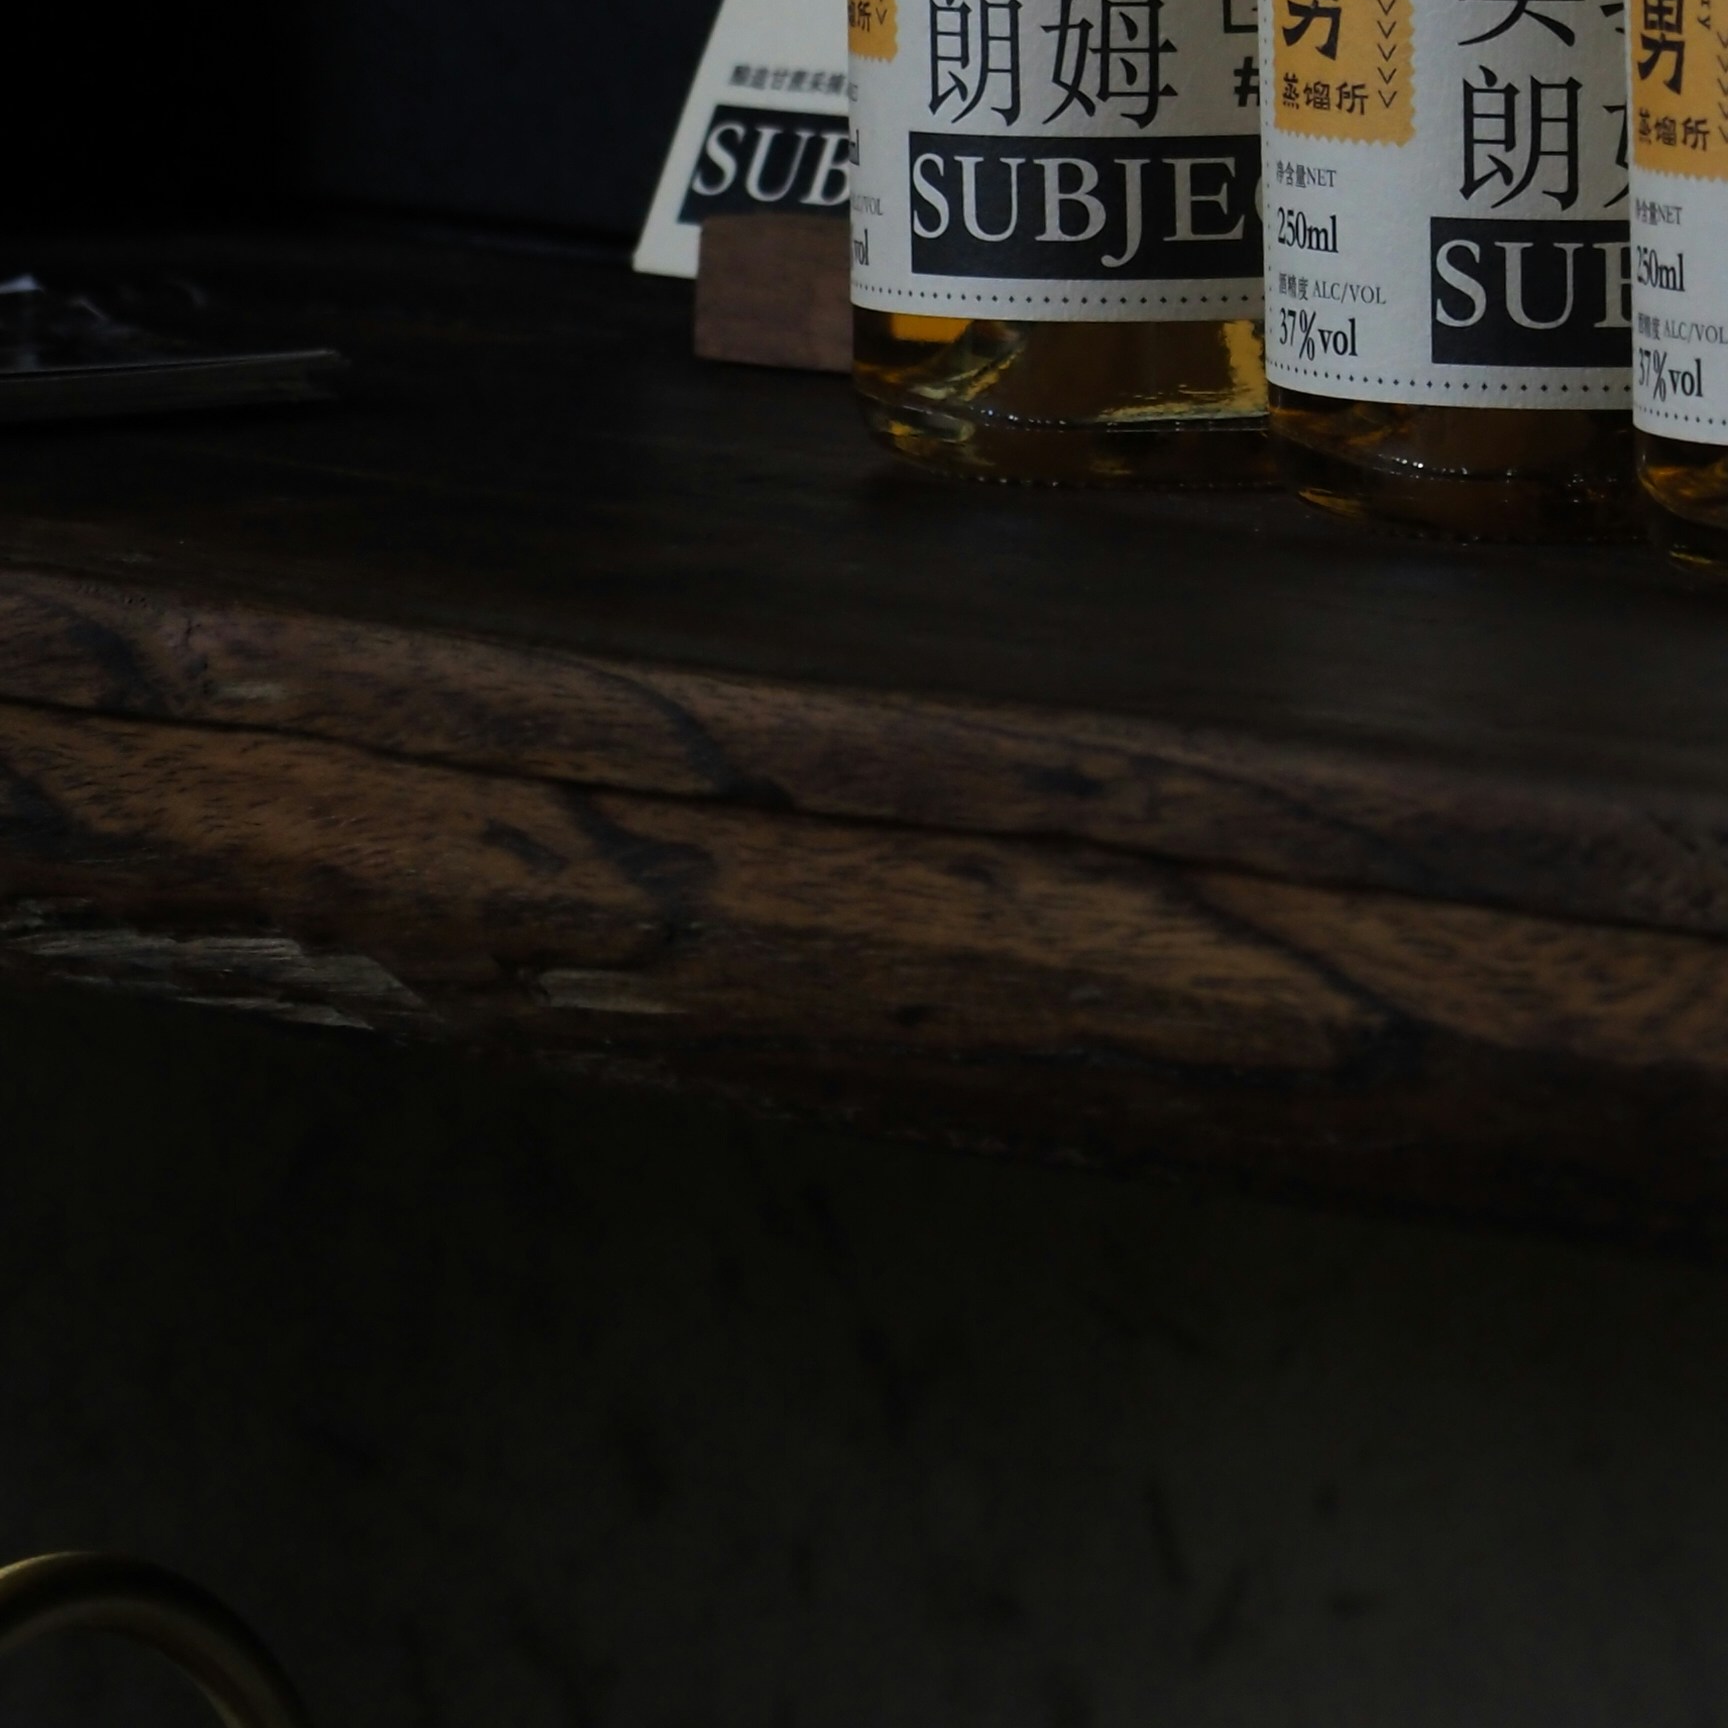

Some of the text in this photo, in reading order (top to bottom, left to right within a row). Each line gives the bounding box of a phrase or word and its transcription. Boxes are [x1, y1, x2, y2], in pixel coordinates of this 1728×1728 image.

[1282, 72, 1369, 115] 蒸馏所
[911, 151, 1263, 268] SUBJE
[1277, 206, 1340, 253] 250ml
[1636, 245, 1686, 292] 250ml
[1313, 280, 1387, 305] ALC/VOL
[1279, 306, 1359, 362] 37%vol
[1664, 319, 1728, 345] ALC/VOL
[1638, 347, 1703, 403] 37%vol
